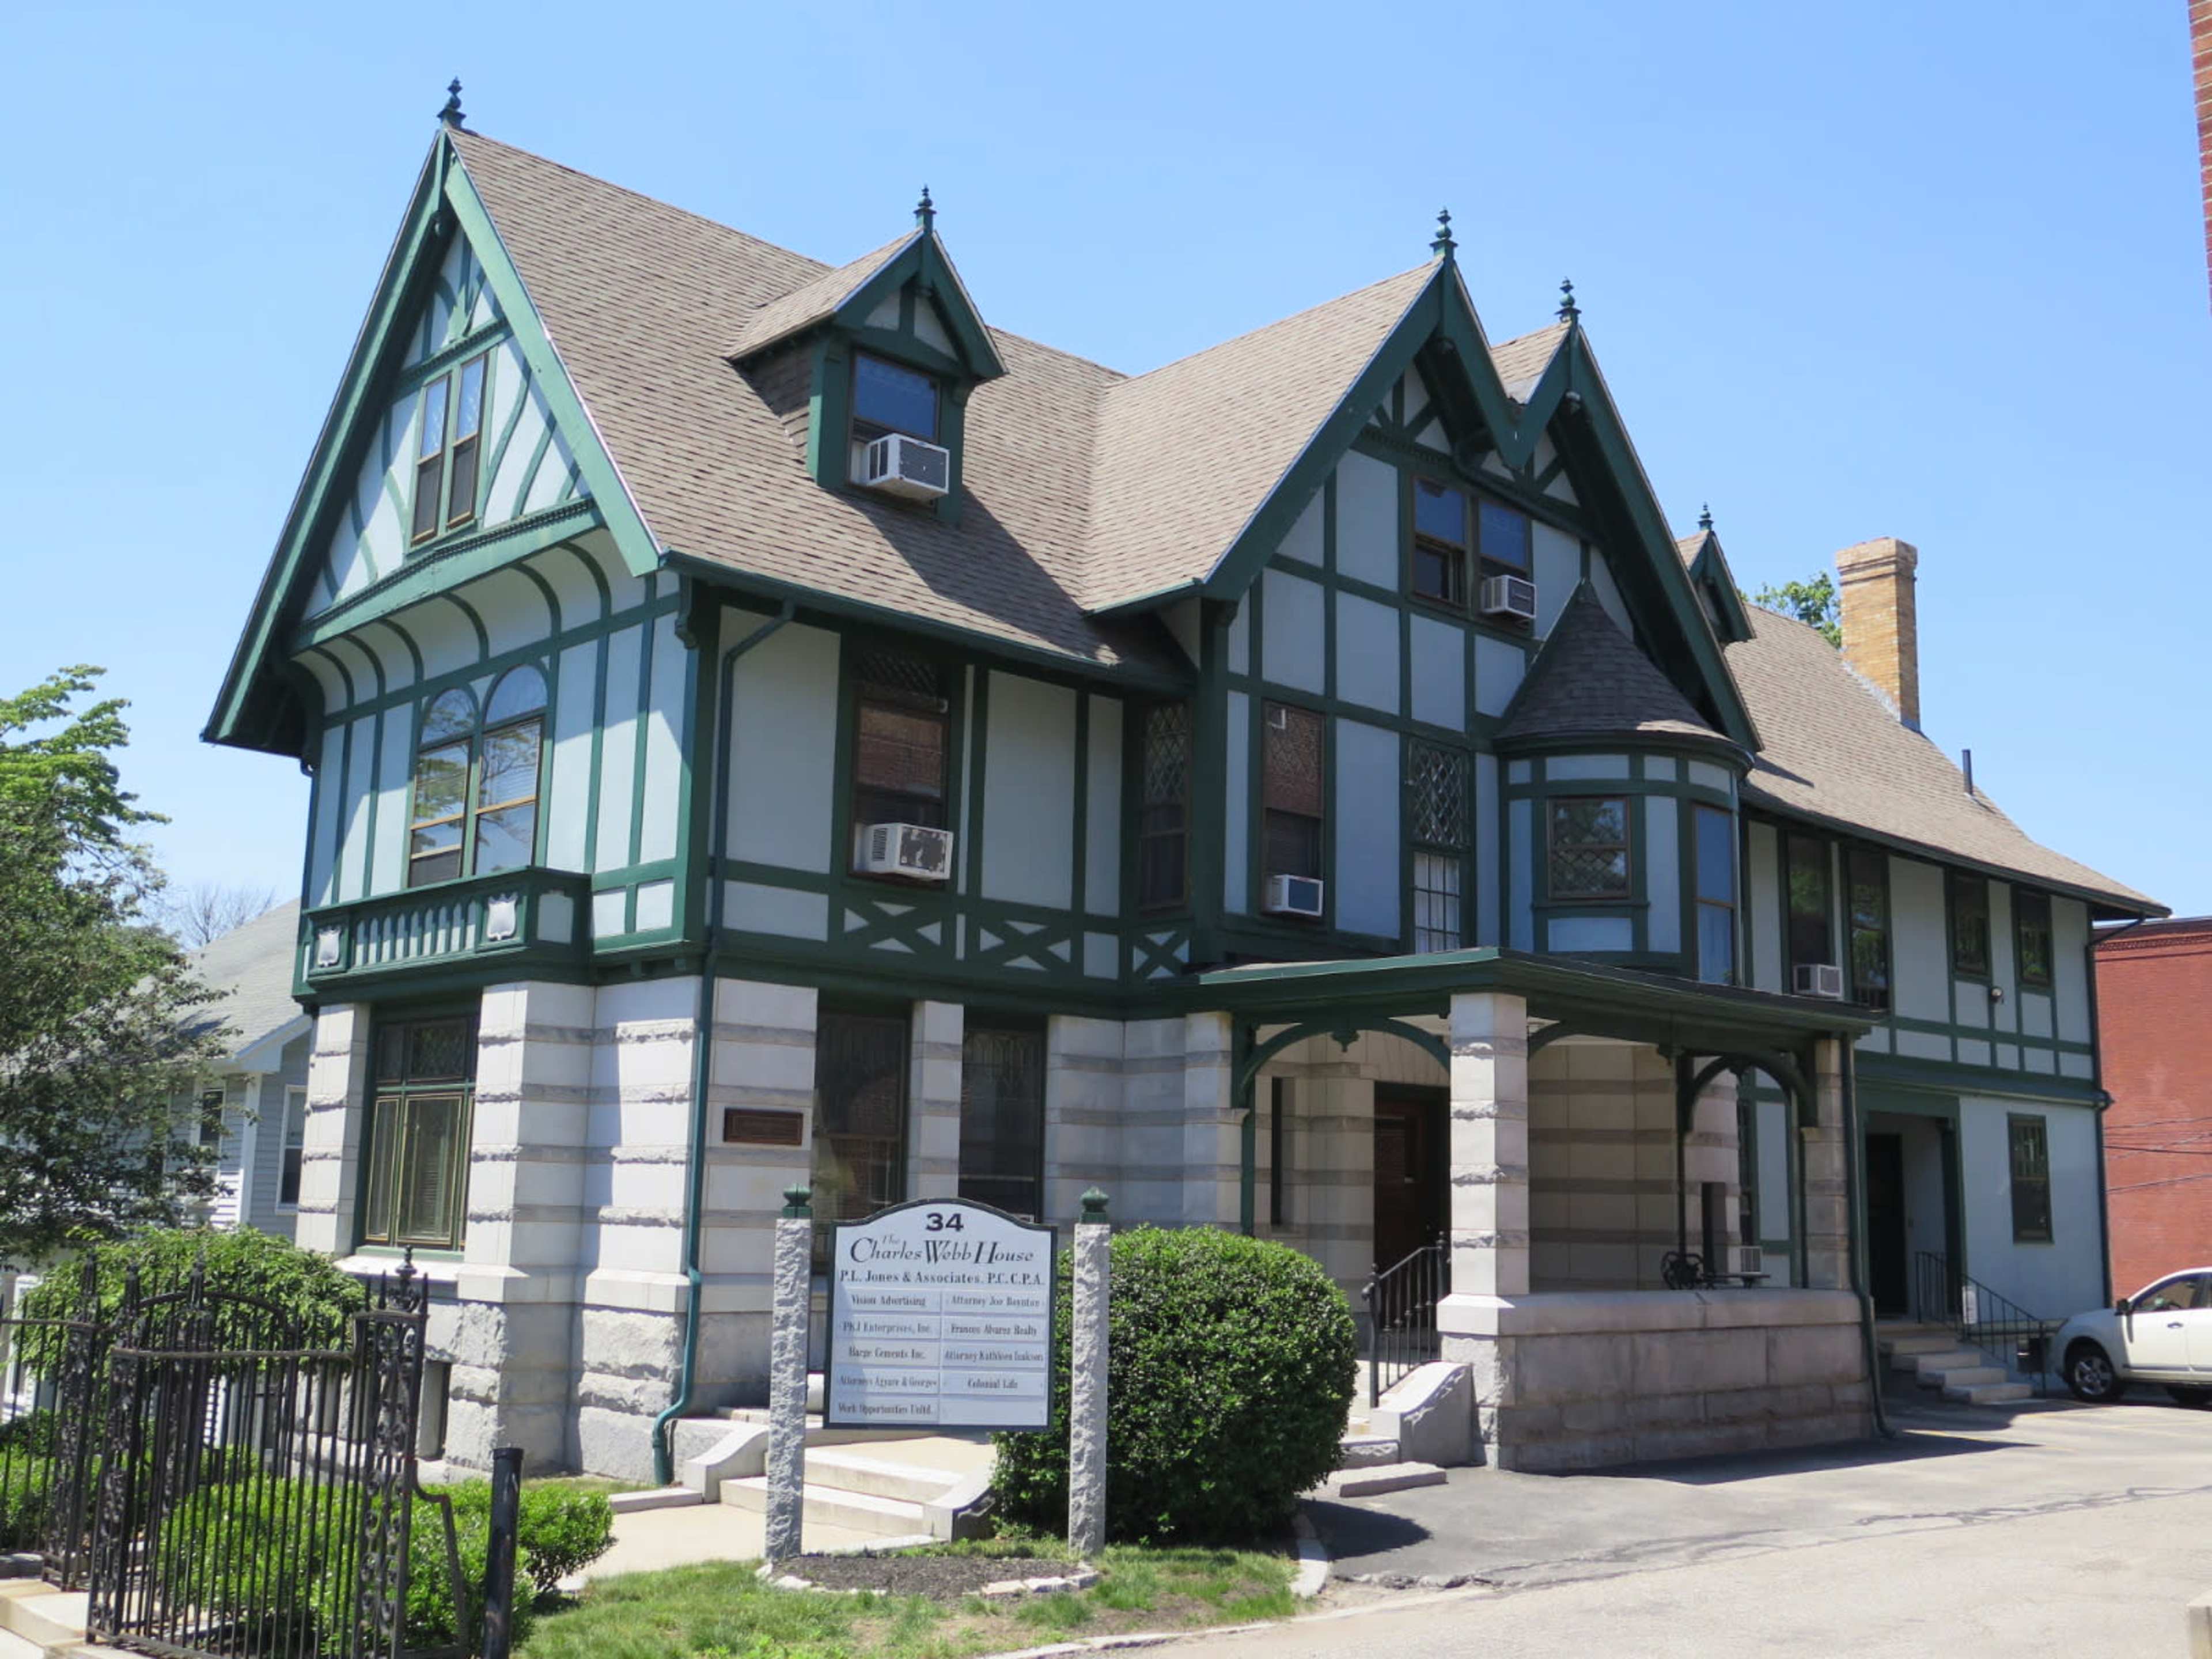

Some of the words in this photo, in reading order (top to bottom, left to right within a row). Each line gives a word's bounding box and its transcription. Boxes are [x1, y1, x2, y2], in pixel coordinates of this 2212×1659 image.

[925, 1213, 964, 1232] 34
[850, 1237, 923, 1263] Charles
[924, 1240, 972, 1264] Webb
[974, 1241, 1034, 1264] House
[840, 1270, 862, 1282] P.L.
[865, 1270, 899, 1282] Jones
[902, 1272, 911, 1283] &
[851, 1294, 876, 1305] Vision
[880, 1294, 926, 1307] Advertising
[951, 1295, 986, 1307] Attorney
[1014, 1324, 1037, 1337] Realty
[944, 1351, 978, 1363] Attorney
[902, 1376, 907, 1387] &
